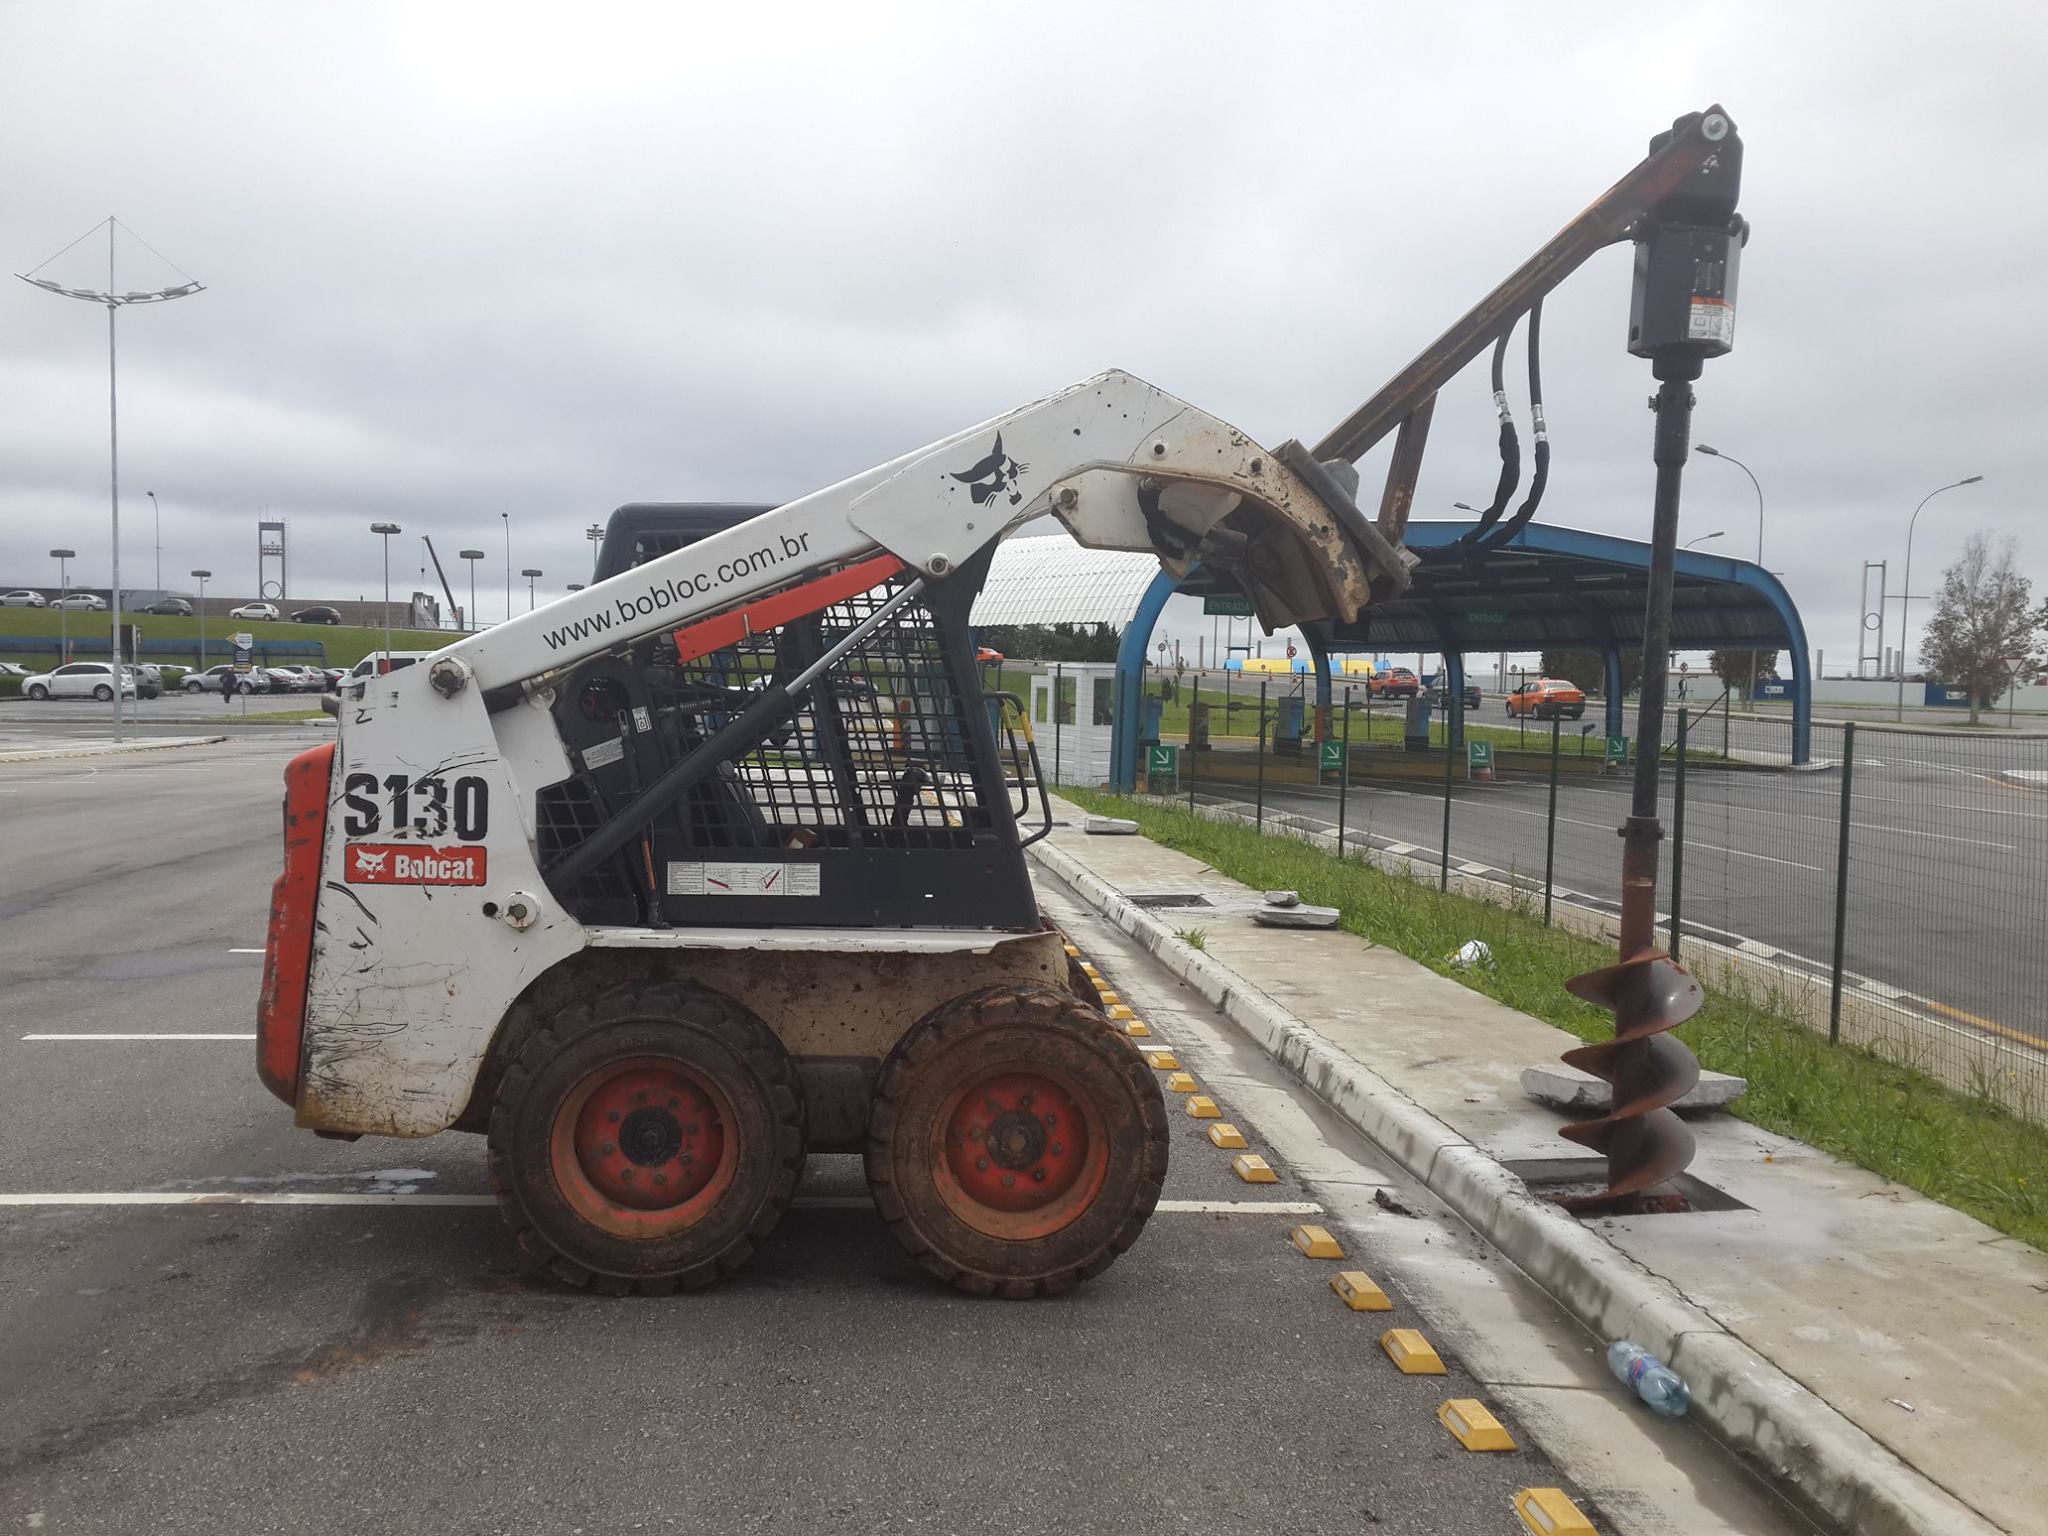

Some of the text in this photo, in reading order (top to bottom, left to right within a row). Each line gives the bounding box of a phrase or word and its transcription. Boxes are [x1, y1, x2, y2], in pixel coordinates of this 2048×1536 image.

[543, 532, 809, 650] www.bobloc.com.br
[1208, 600, 1251, 612] ENTRADA
[344, 772, 489, 841] S130
[395, 854, 474, 880] Bobcat
